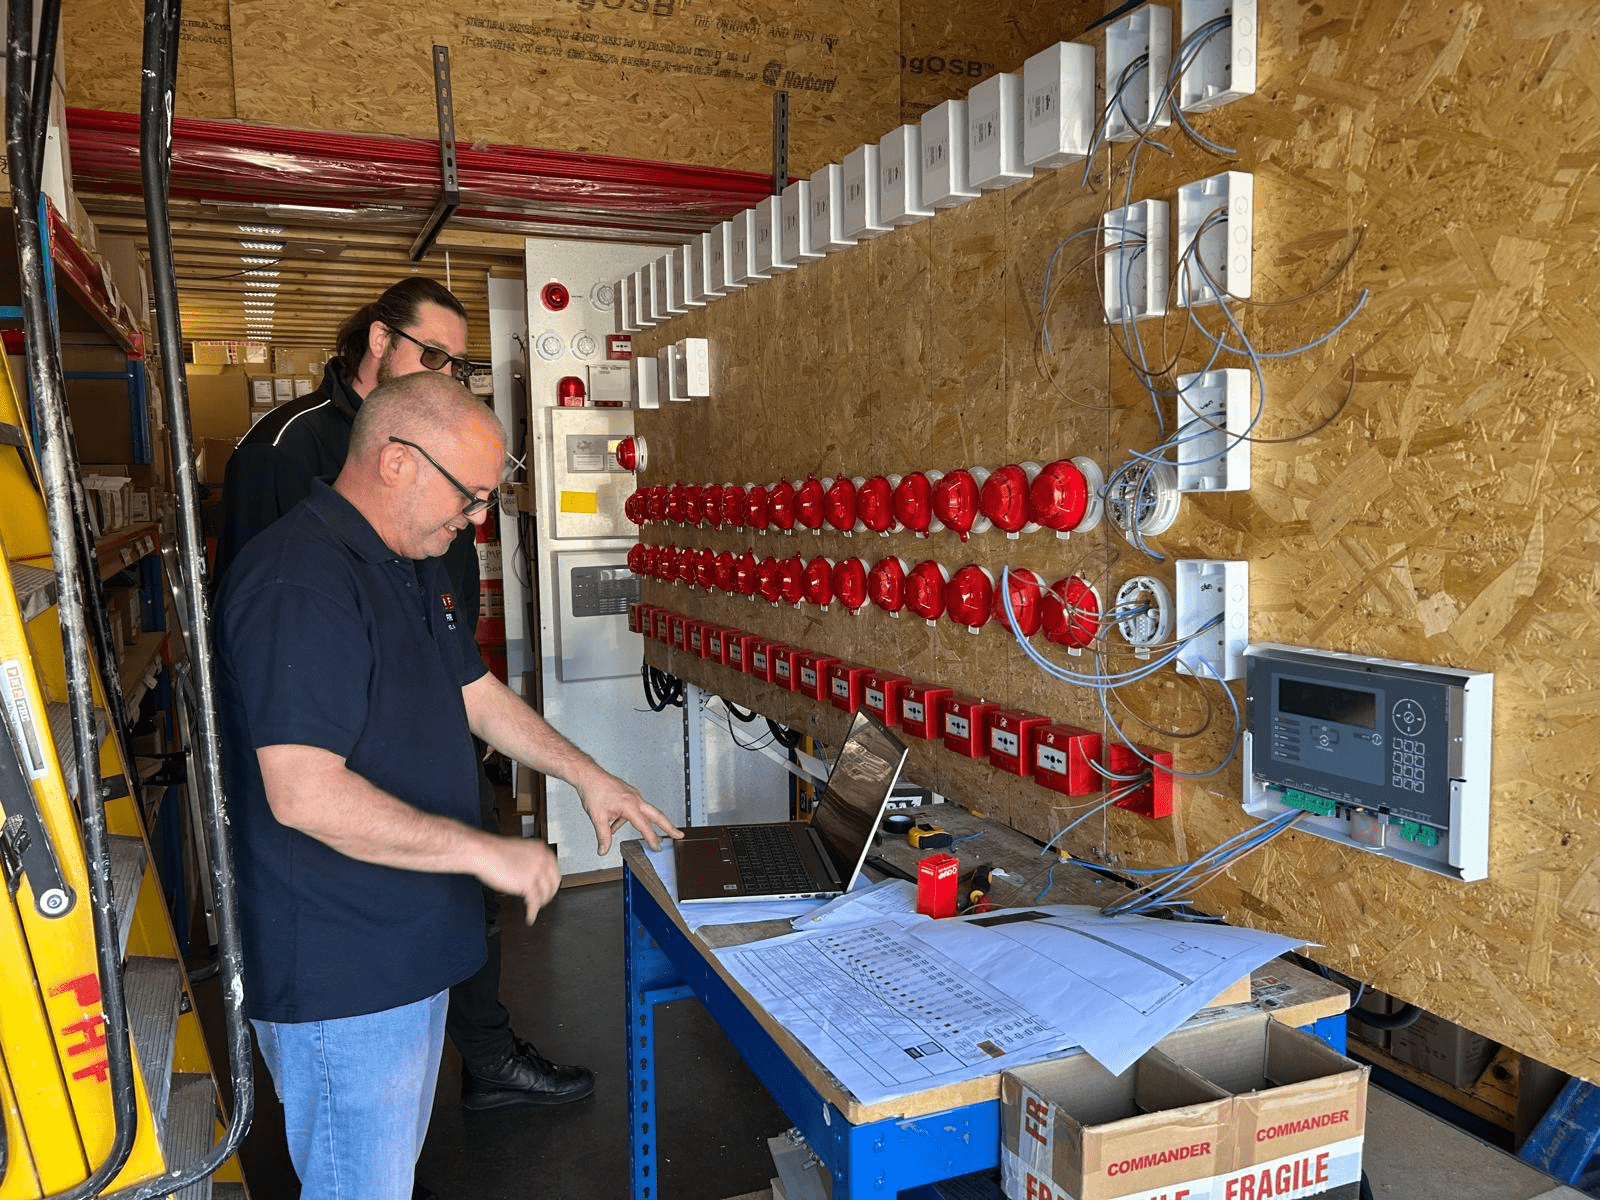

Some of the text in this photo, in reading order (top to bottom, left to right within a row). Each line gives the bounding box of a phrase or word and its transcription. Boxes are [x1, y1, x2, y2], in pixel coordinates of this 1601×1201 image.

[694, 14, 710, 29] THE
[716, 18, 760, 34] ORIGINAL
[769, 26, 790, 39] AND
[783, 71, 838, 93] Norbord
[1256, 1109, 1349, 1142] COMMANDER
[1107, 1142, 1211, 1177] COMMANDER
[1225, 1152, 1330, 1200] FRAGILE
